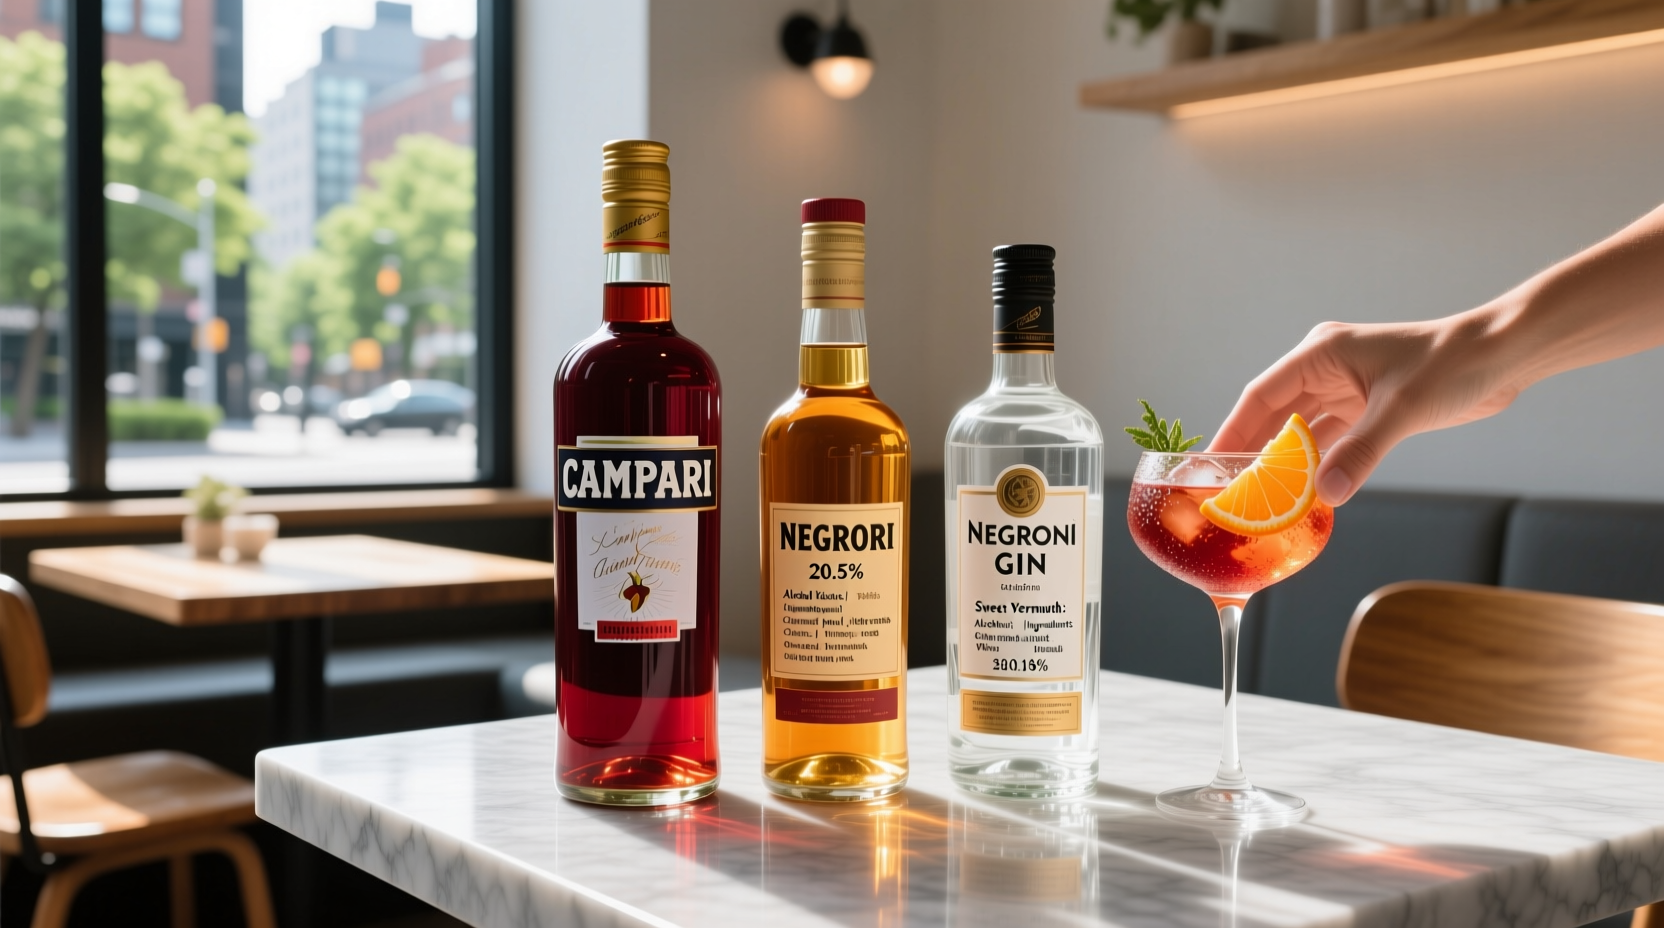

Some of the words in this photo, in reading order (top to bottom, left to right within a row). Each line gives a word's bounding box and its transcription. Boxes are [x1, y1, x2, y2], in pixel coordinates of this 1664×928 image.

[562, 458, 712, 499] CAMPARI
[780, 522, 895, 552] NEGRORI
[968, 519, 1076, 546] NEGRONI
[808, 563, 864, 580] 20.5%
[994, 552, 1046, 575] GIN
